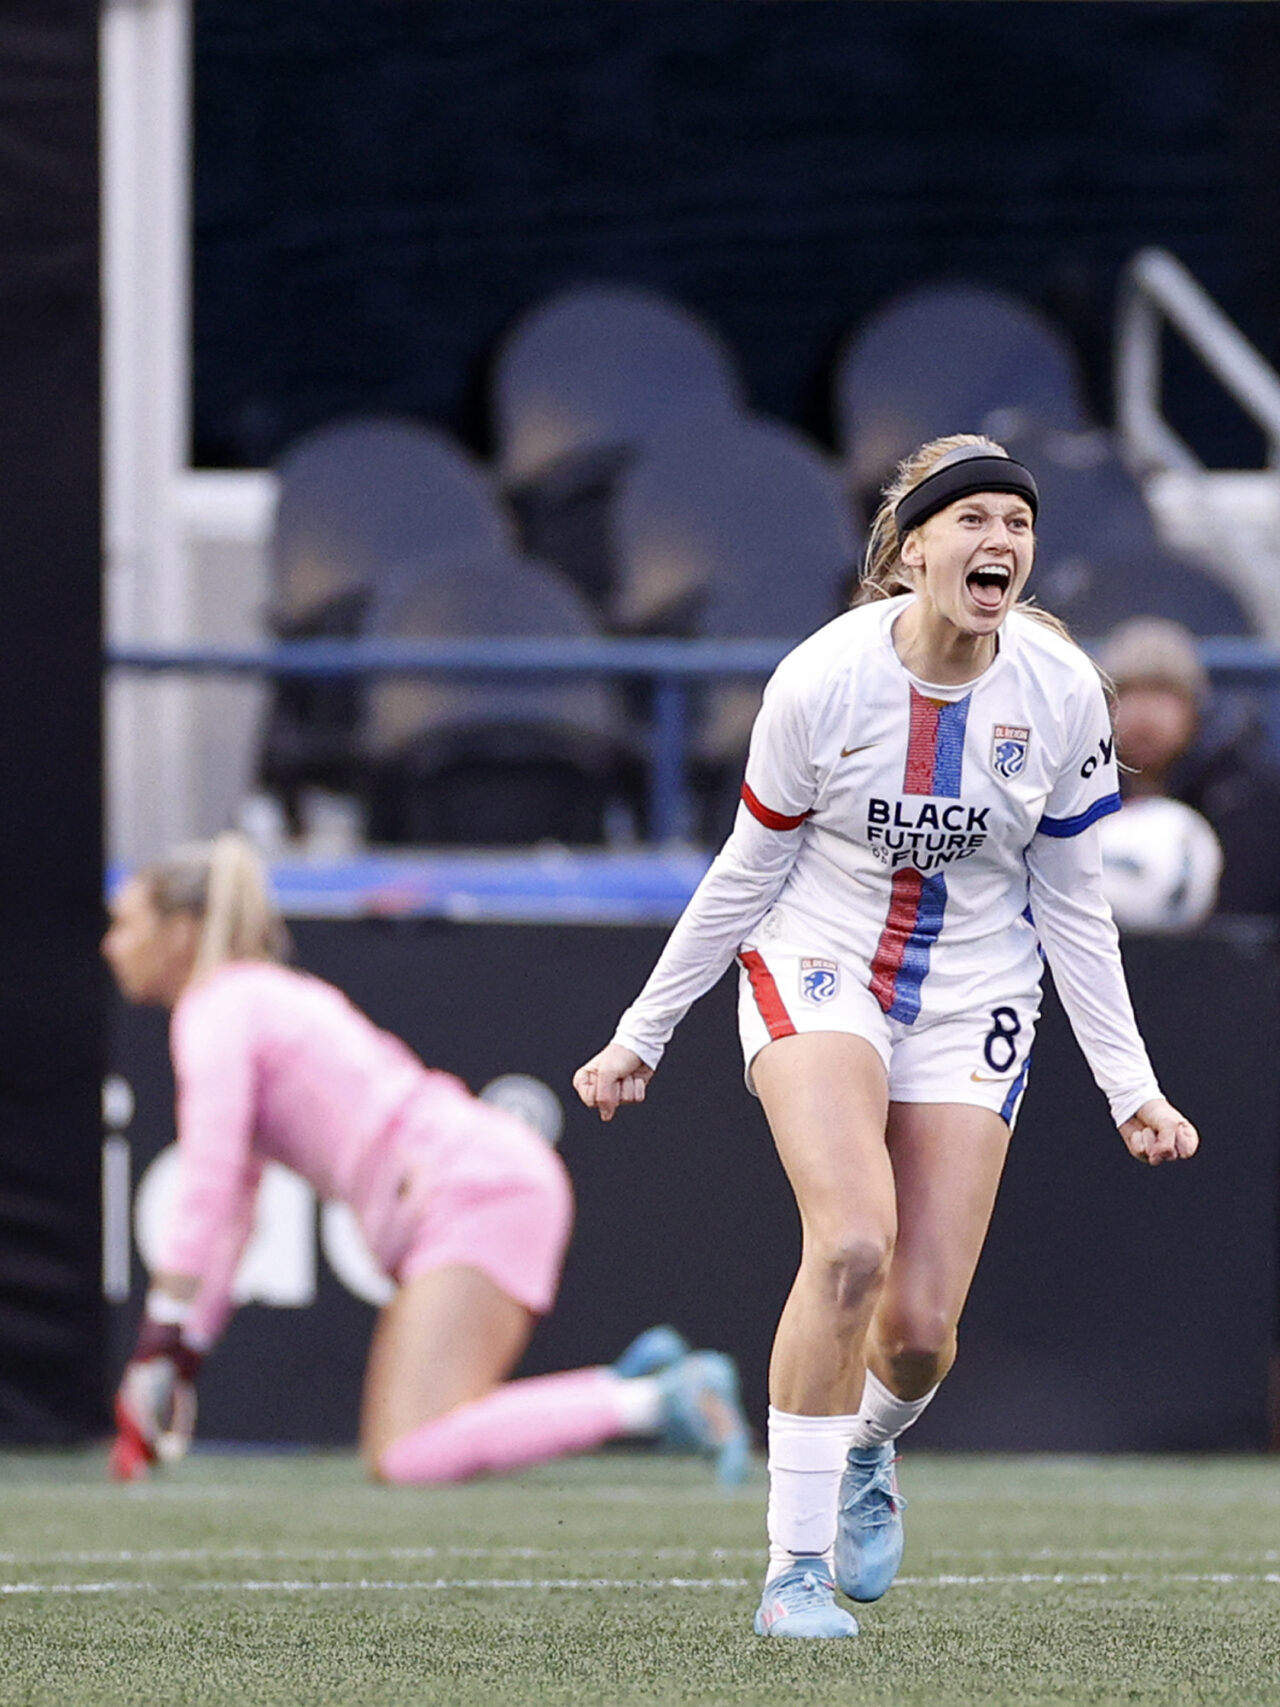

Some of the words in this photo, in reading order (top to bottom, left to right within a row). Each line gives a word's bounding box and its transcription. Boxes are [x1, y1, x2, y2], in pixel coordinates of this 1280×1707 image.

[868, 798, 990, 831] BLACK
[868, 826, 987, 851] FUTURE
[891, 849, 976, 870] FUND
[984, 1006, 1021, 1073] 8
